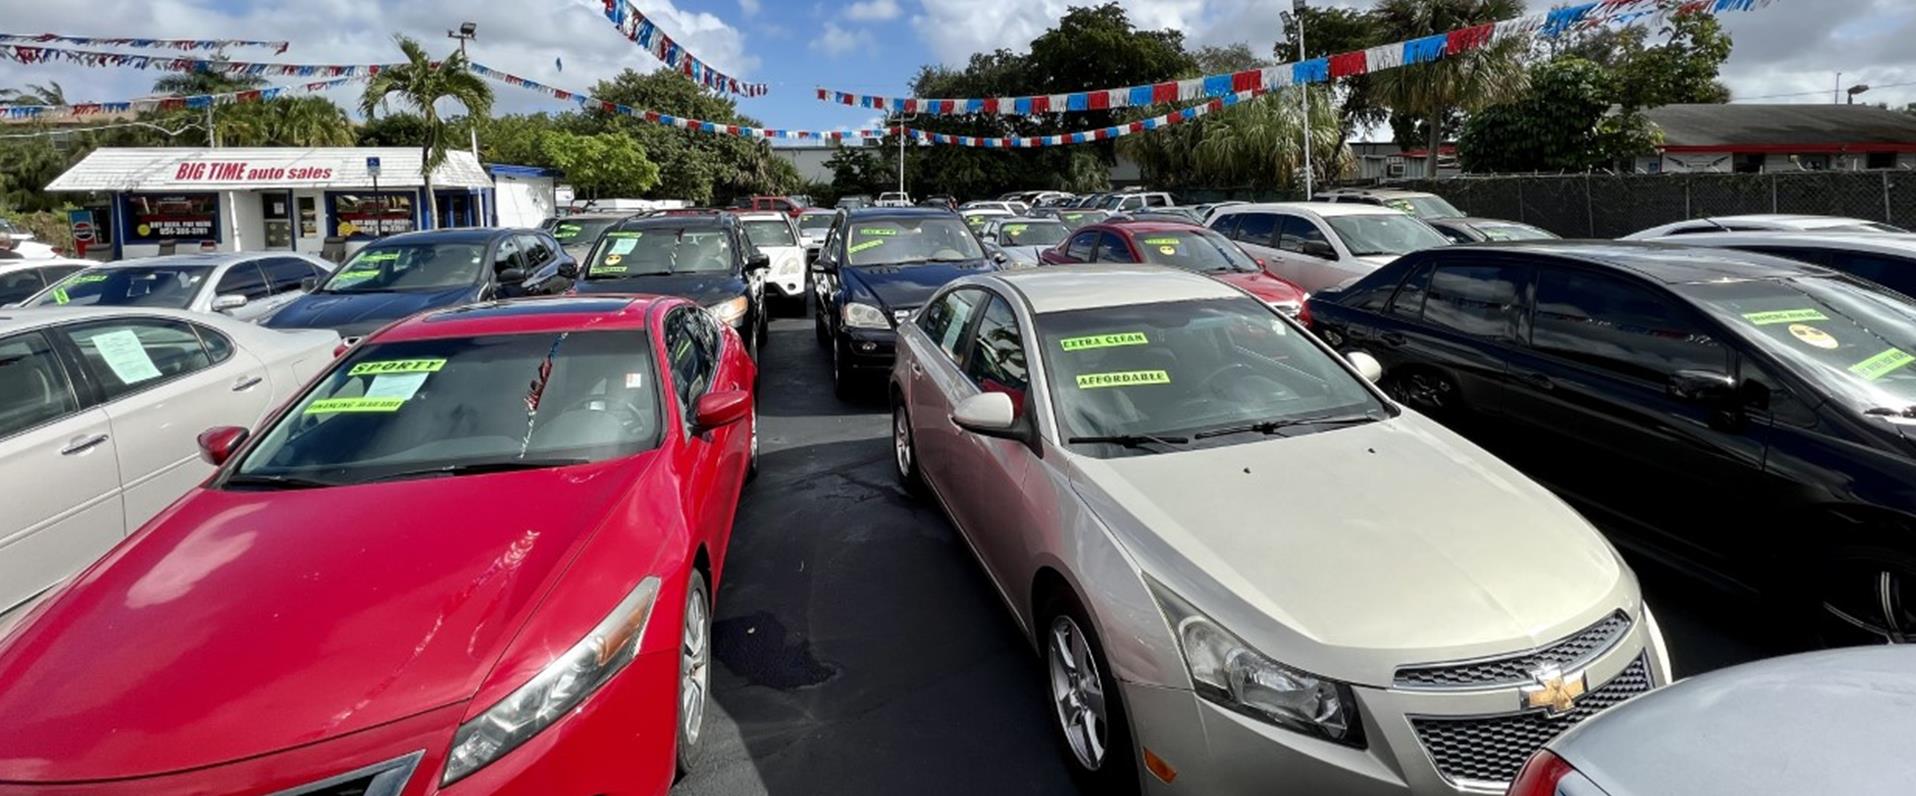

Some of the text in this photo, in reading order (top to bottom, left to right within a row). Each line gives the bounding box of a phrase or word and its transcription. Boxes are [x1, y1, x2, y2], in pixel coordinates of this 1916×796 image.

[175, 162, 332, 180] BIG TIME auto sales
[1063, 334, 1144, 348] EXTRA CLEAN
[353, 361, 442, 373] SPORTY
[1080, 373, 1165, 385] AFFORDABLE
